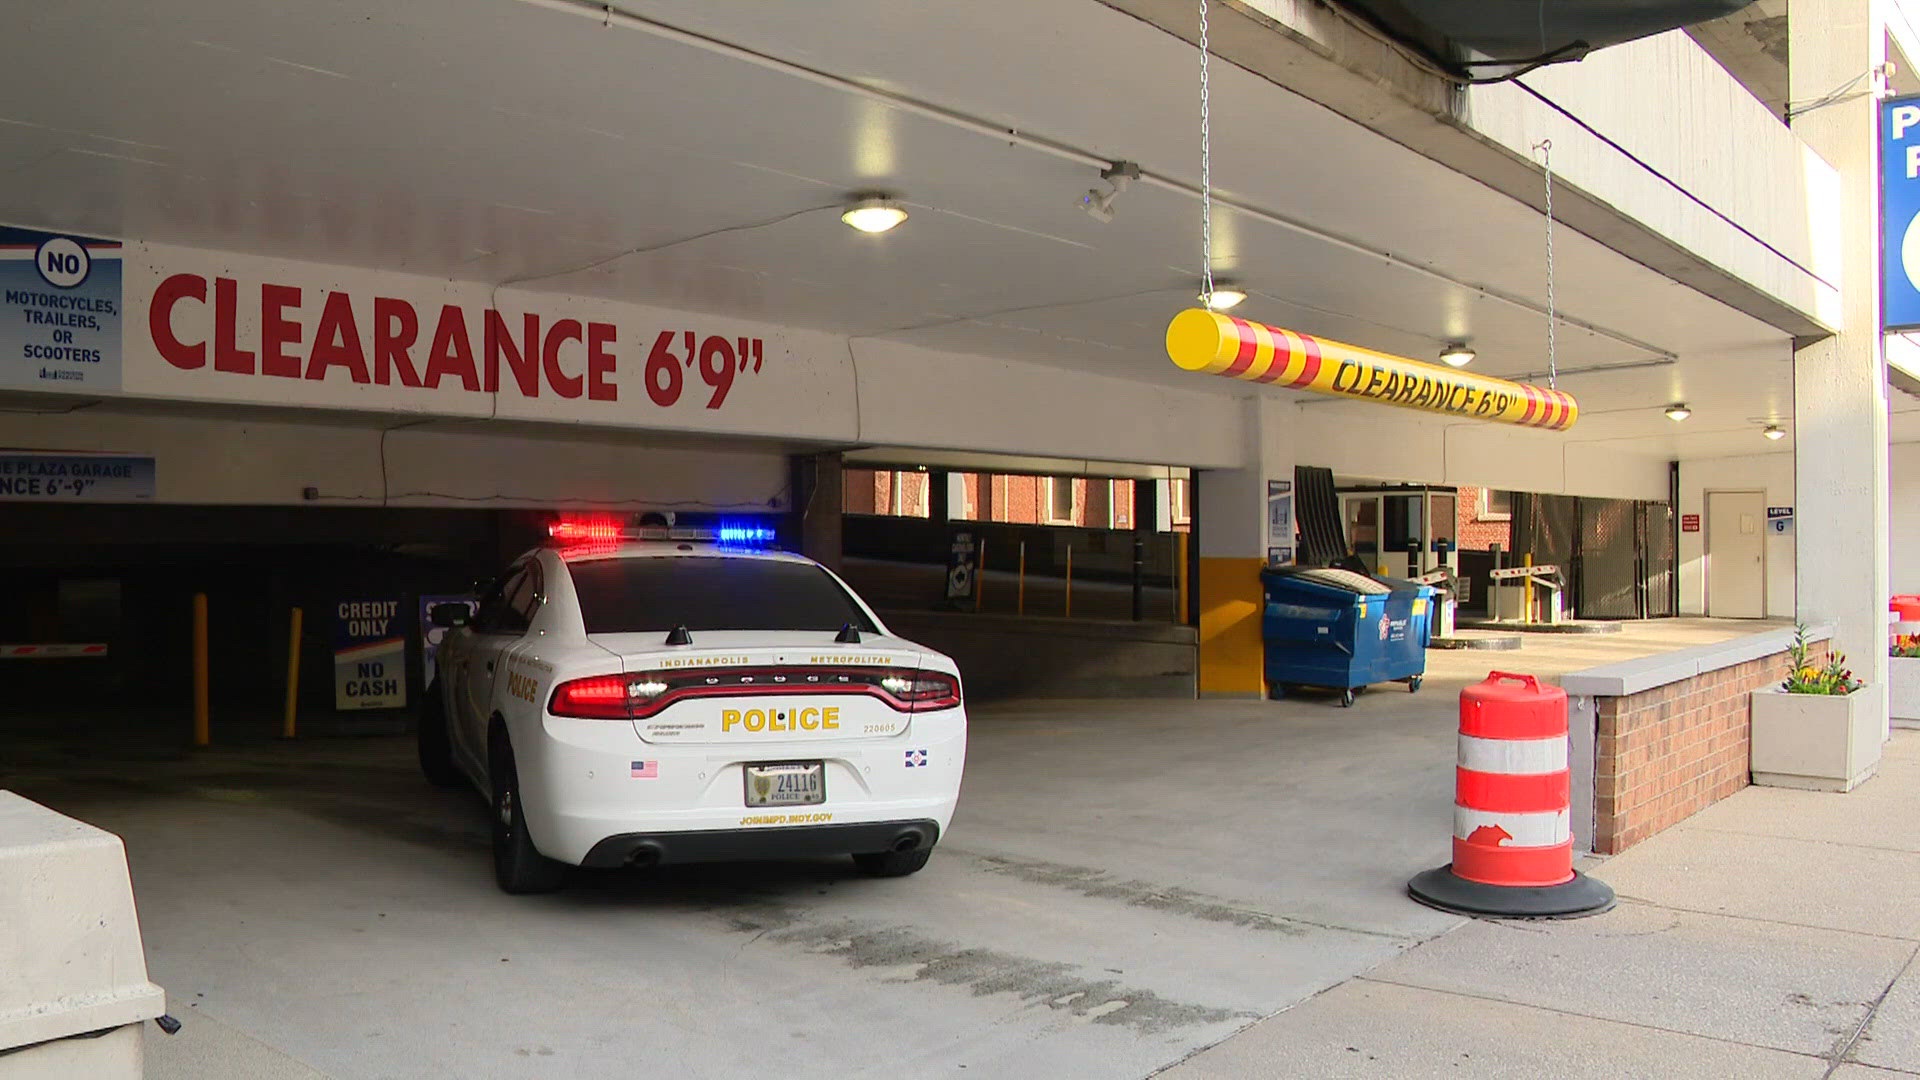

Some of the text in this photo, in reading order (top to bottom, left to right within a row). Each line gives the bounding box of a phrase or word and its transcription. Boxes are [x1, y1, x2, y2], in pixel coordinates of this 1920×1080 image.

[47, 251, 80, 275] NO
[6, 289, 117, 316] MOTORCYCLES,
[24, 309, 101, 332] TRAILERS,
[53, 329, 73, 344] OR
[149, 273, 617, 402] CLEARANCE
[24, 345, 101, 363] SCOOTERS
[1332, 359, 1476, 414] CLEARANCE
[17, 462, 67, 477] PLAZA
[71, 463, 133, 478] GARAGE
[1776, 521, 1785, 532] G
[338, 601, 398, 620] CREDIT
[349, 619, 389, 637] ONLY
[660, 656, 749, 668] INDIANAPOLIS
[810, 655, 892, 664] METROPOLITAN
[357, 662, 384, 679] NO
[345, 680, 397, 698] CASH
[507, 671, 538, 704] POLICE
[721, 706, 840, 733] POLICE
[777, 773, 817, 793] 24116
[771, 792, 799, 801] POLICE
